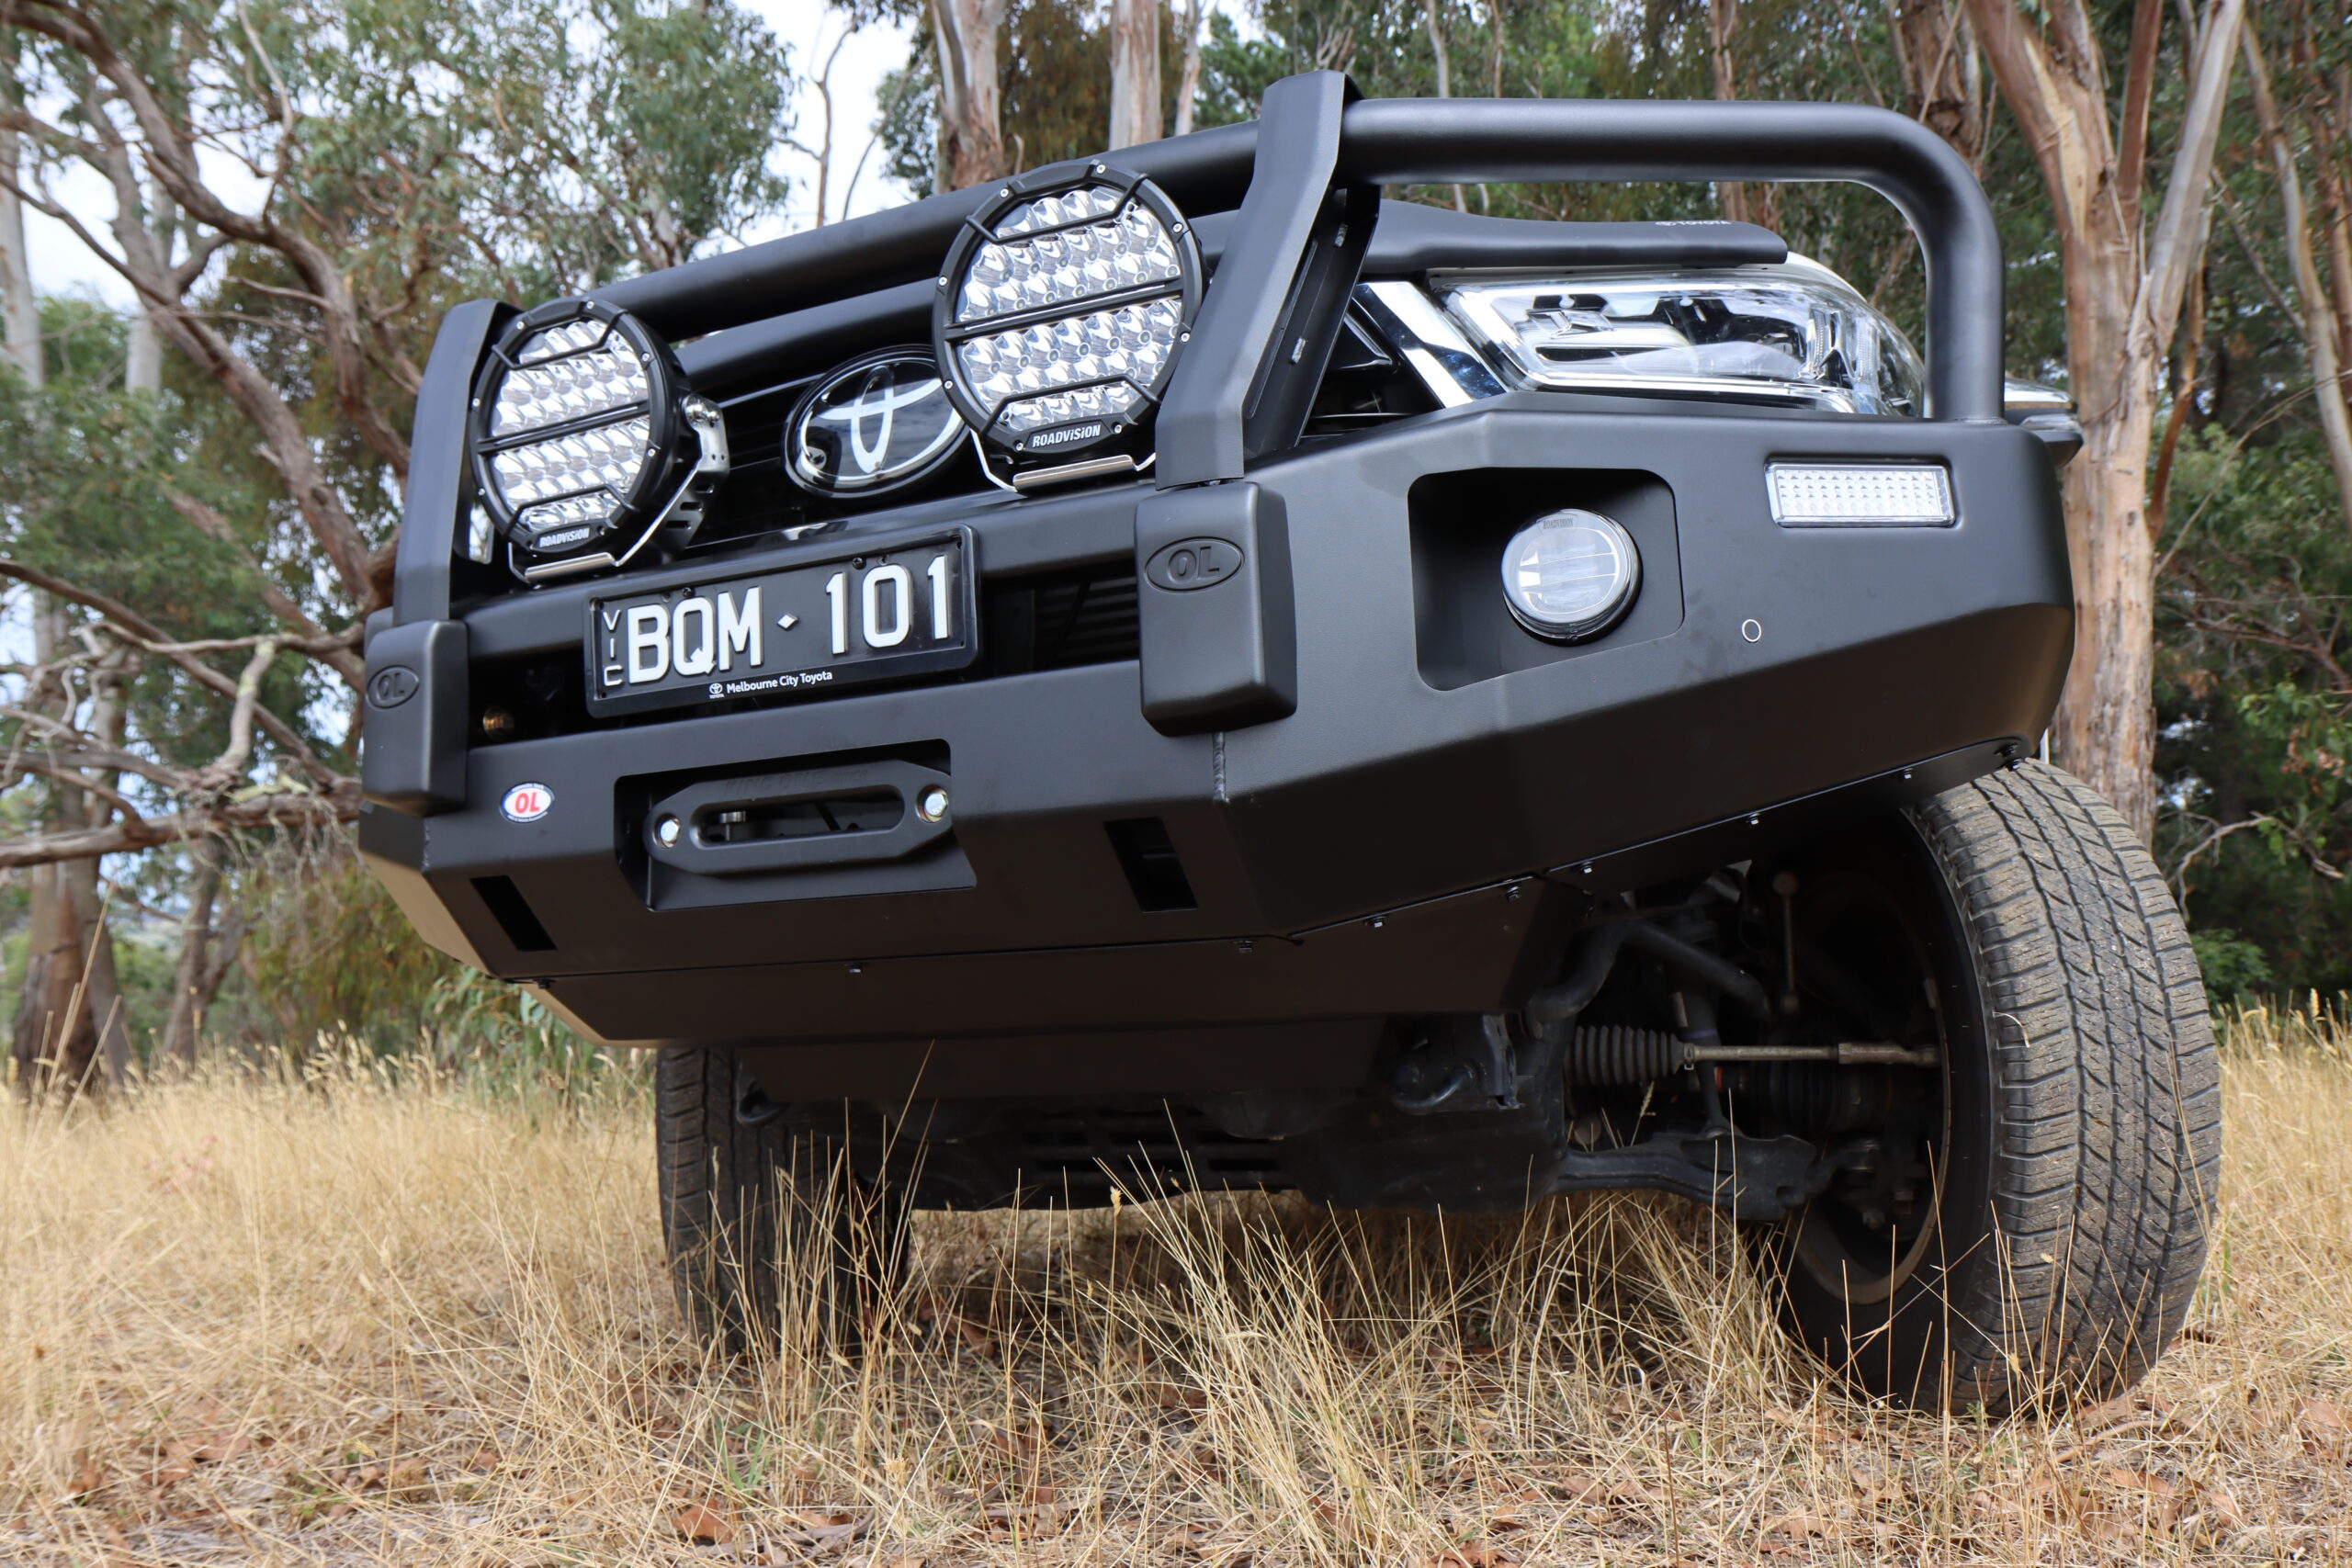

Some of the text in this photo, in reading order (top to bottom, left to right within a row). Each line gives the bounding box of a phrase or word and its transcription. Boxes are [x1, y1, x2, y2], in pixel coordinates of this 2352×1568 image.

[1167, 546, 1220, 584] OL
[628, 554, 951, 684] BQM 101
[603, 609, 623, 686] VIC
[377, 672, 405, 702] OL
[726, 671, 833, 694] Melbourne City Toyota
[515, 792, 540, 814] OL
